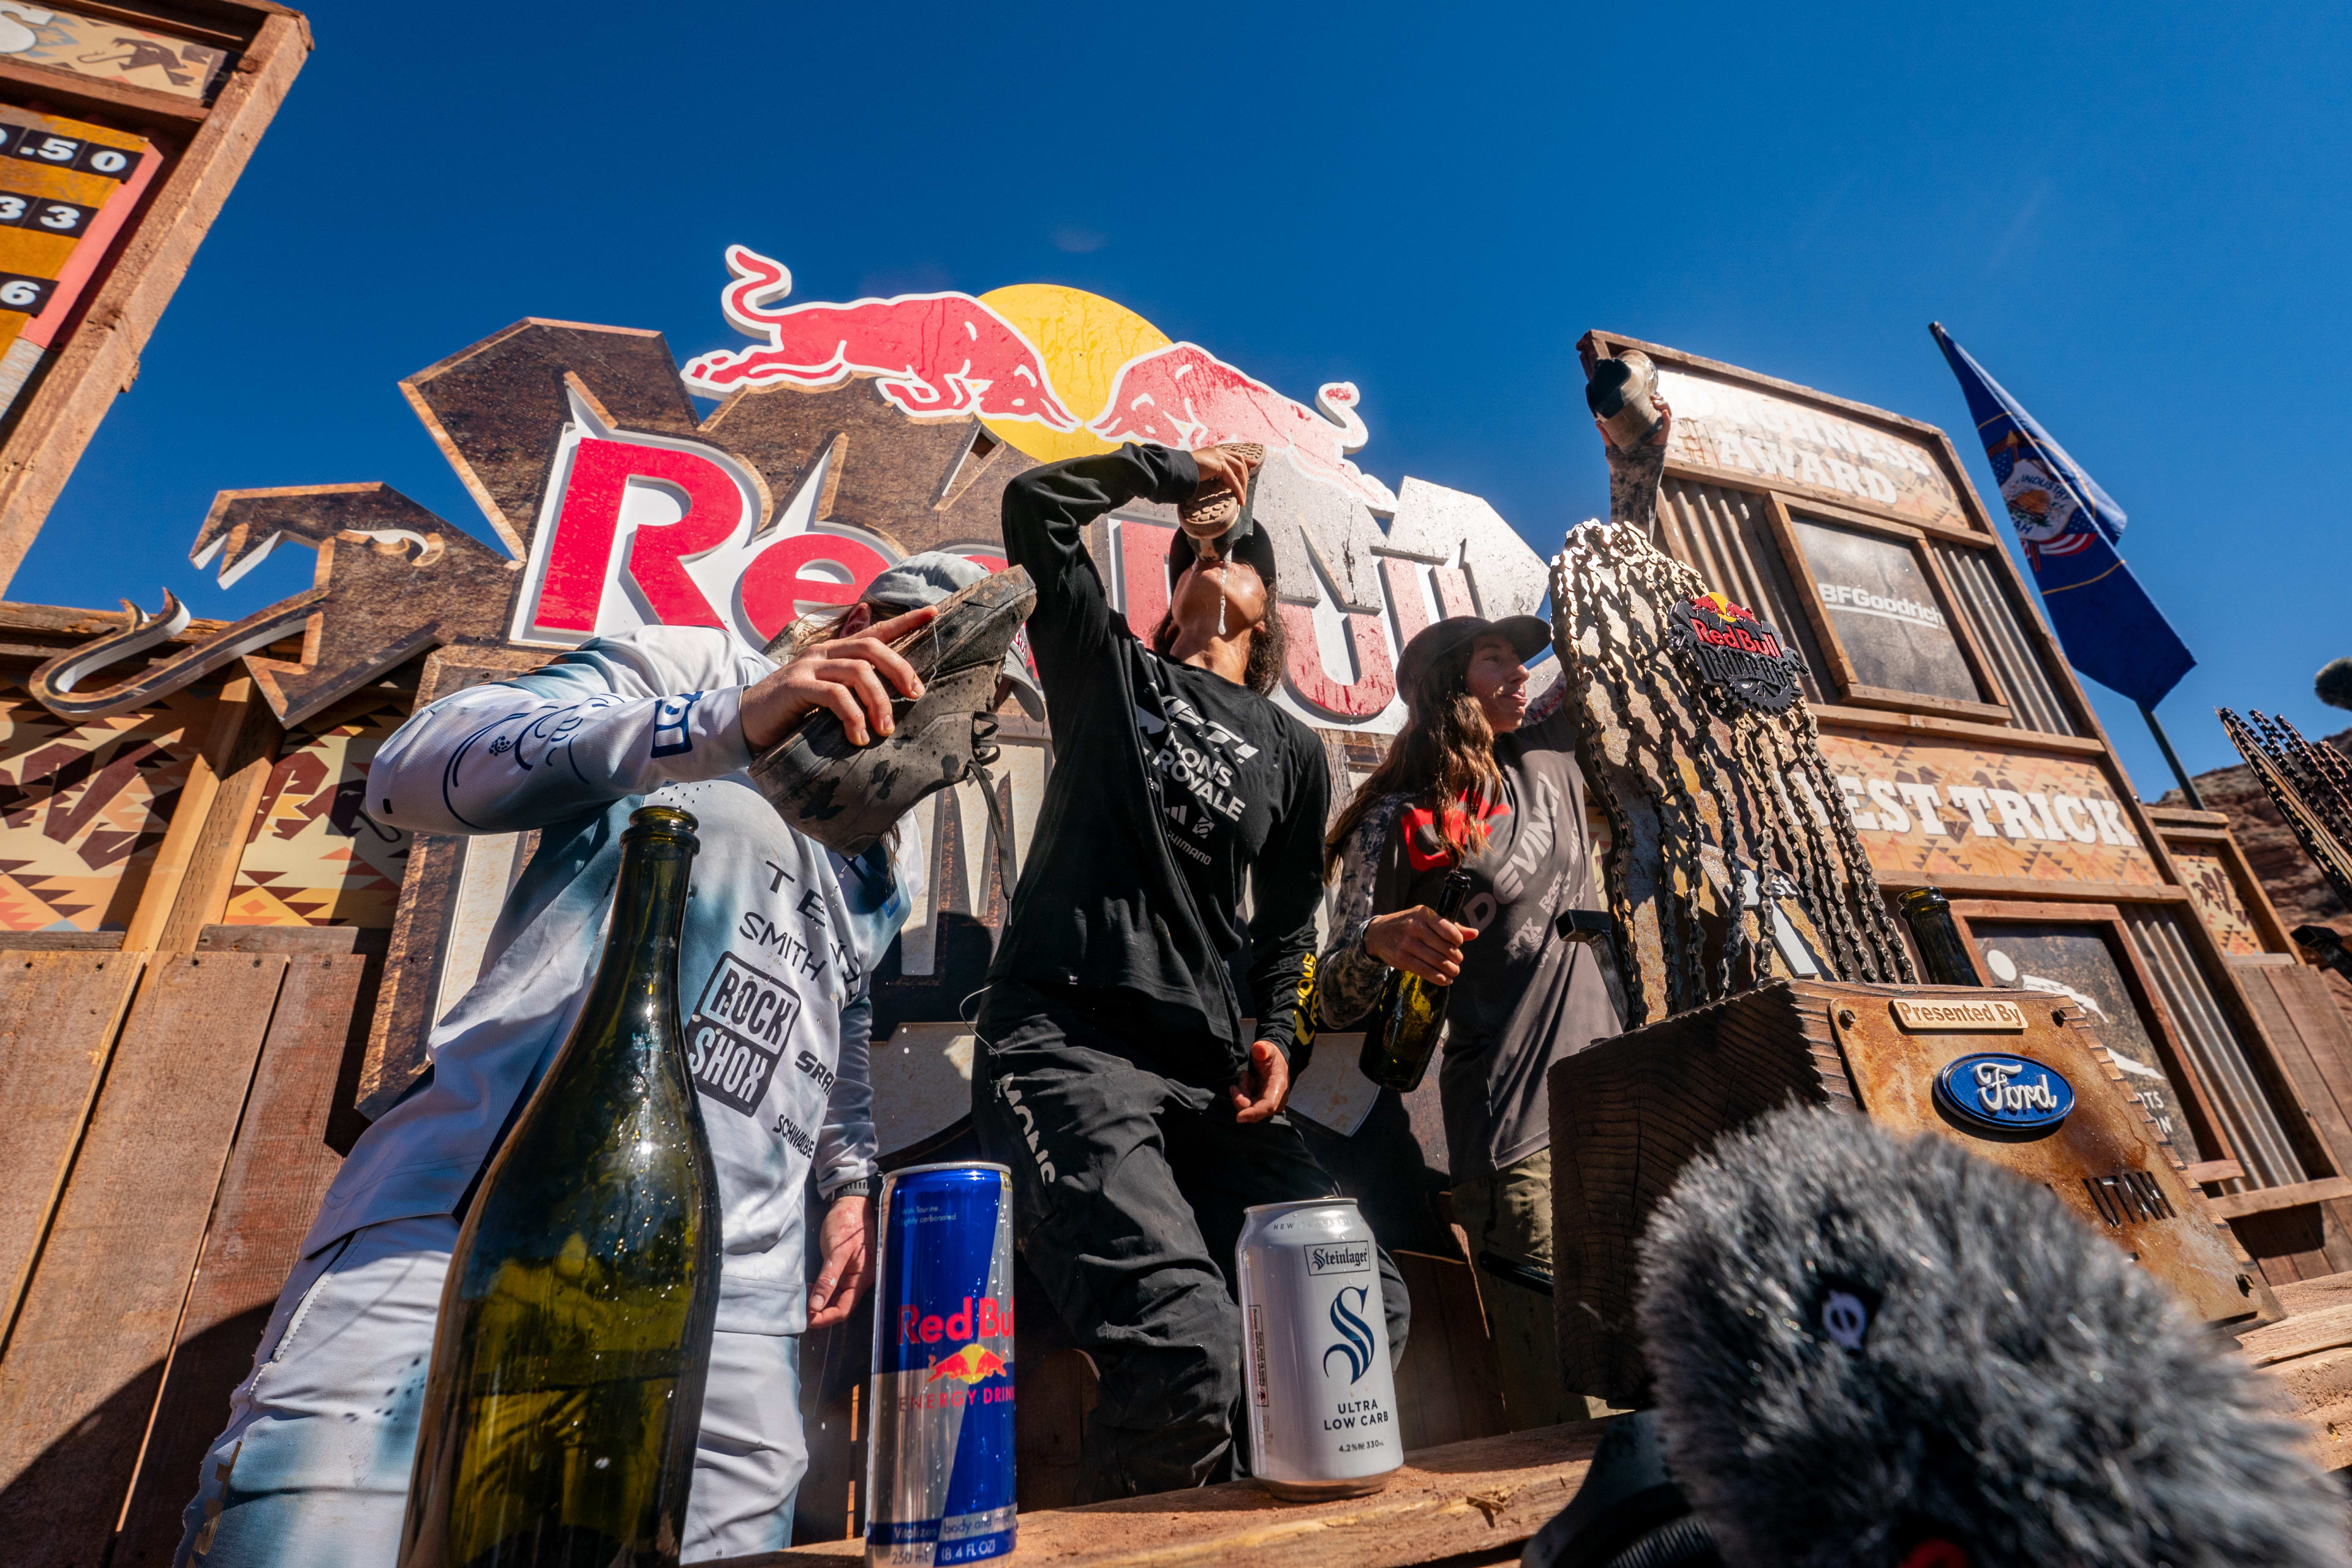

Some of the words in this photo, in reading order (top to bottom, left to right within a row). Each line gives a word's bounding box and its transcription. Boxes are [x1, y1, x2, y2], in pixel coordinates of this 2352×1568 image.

[0, 127, 127, 172] .50
[1717, 431, 1898, 504] AWARD
[2021, 474, 2073, 501] INDUSTRY
[1817, 582, 1945, 625] BFGoodrich
[1691, 618, 1741, 649] Red
[1735, 627, 1784, 658] Bull
[1164, 731, 1234, 787] MONS
[1153, 748, 1246, 822] ROYALE
[1948, 785, 2138, 847] TRICK
[1167, 832, 1212, 866] HIMANO
[739, 911, 827, 982] SMITH
[709, 967, 793, 1046] ROCK
[1896, 1001, 1995, 1022] Presented
[1995, 1005, 2022, 1026] By
[688, 1027, 769, 1103] SHOX
[794, 1050, 835, 1099] SRA
[1974, 1062, 2057, 1113] Ford
[772, 1114, 815, 1159] SCHWALBE
[2082, 1170, 2177, 1227] UTAH
[1311, 1247, 1368, 1271] Steinlager
[897, 1297, 972, 1345] Red
[899, 1388, 977, 1412] ENERGY
[1324, 1417, 1355, 1431] LOW
[1360, 1411, 1389, 1426] CARB
[1338, 1398, 1378, 1414] ULTRA
[892, 1551, 912, 1565] 250
[966, 1543, 977, 1558] FL
